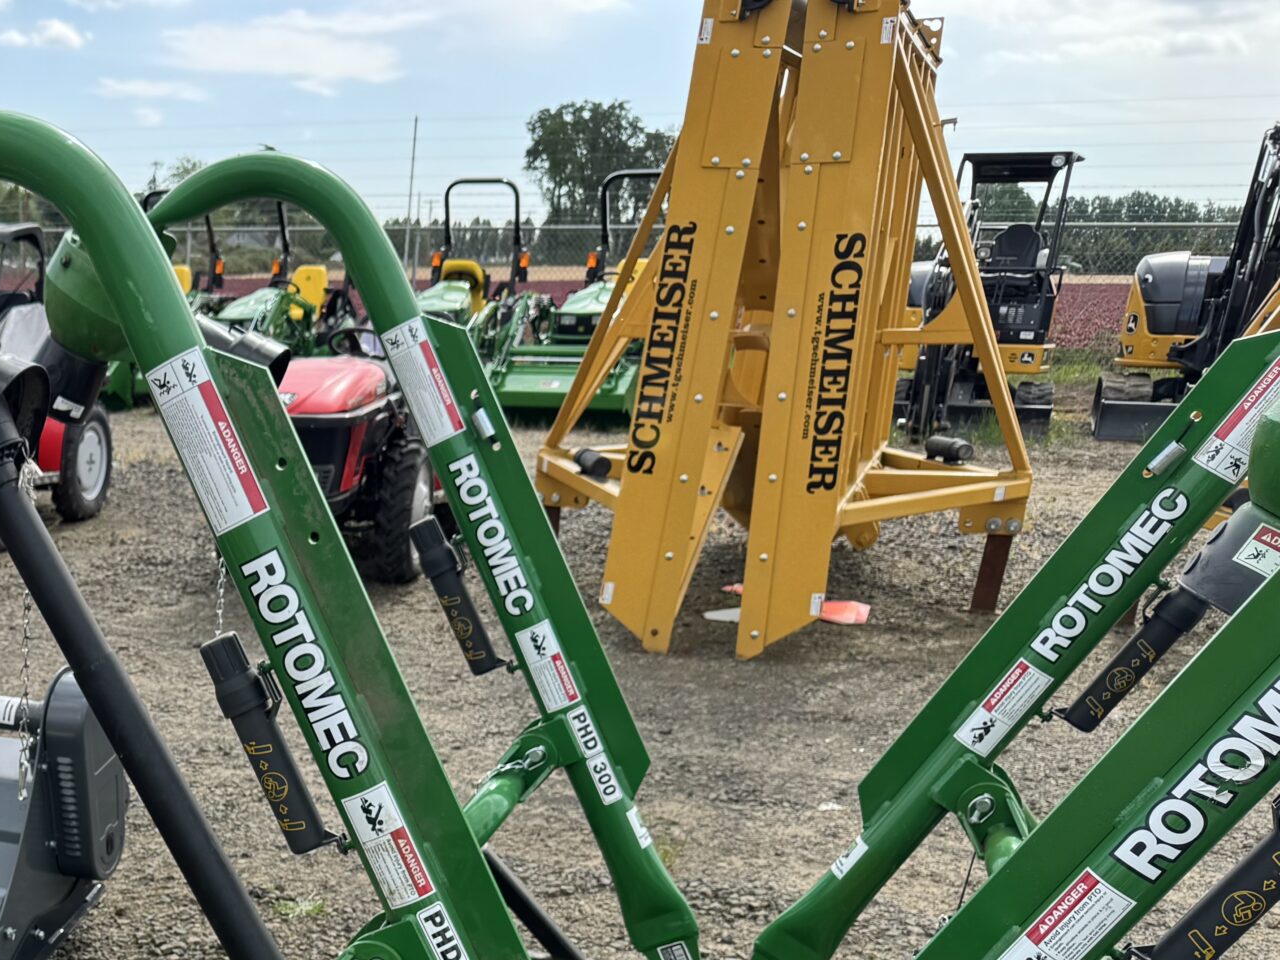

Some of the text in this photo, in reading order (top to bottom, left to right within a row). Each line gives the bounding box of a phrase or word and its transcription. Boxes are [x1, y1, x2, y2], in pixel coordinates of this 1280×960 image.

[627, 222, 697, 475] SCHMEISER
[665, 278, 698, 423] www.tgschmeiser.com
[801, 291, 825, 440] www.tgschmeiser.com
[806, 232, 866, 493] SCHMEISER
[433, 373, 452, 405] DANGER
[221, 427, 247, 475] DANGER
[449, 453, 534, 617] ROTOMEC
[1029, 487, 1189, 663] ROTOMEC
[240, 548, 369, 779] ROTOMEC
[557, 664, 574, 695] DANGER
[994, 667, 1022, 698] DANGER
[572, 712, 598, 751] PHD
[593, 761, 617, 797] 300
[1113, 678, 1280, 882] ROTOM
[401, 845, 425, 887] DANGER
[1042, 886, 1101, 948] Avoid injury from PTO
[1043, 881, 1087, 927] DANGER
